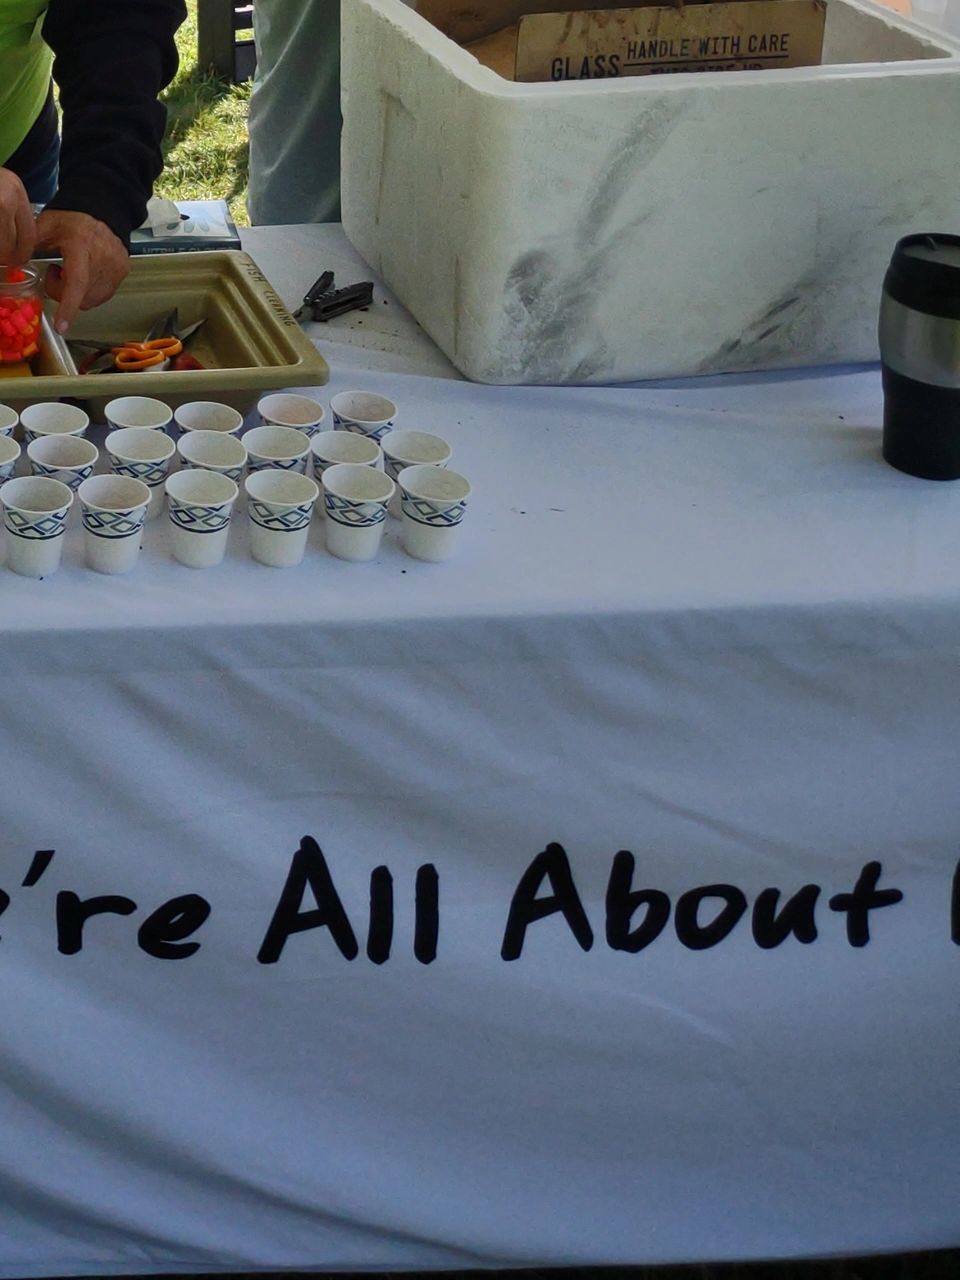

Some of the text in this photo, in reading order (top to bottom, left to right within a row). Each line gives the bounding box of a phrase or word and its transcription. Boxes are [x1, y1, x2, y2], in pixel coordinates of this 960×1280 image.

[627, 33, 791, 60] HANDLE WITH CARE
[551, 53, 621, 82] GLASS
[255, 834, 440, 965] All
[500, 840, 904, 963] About
